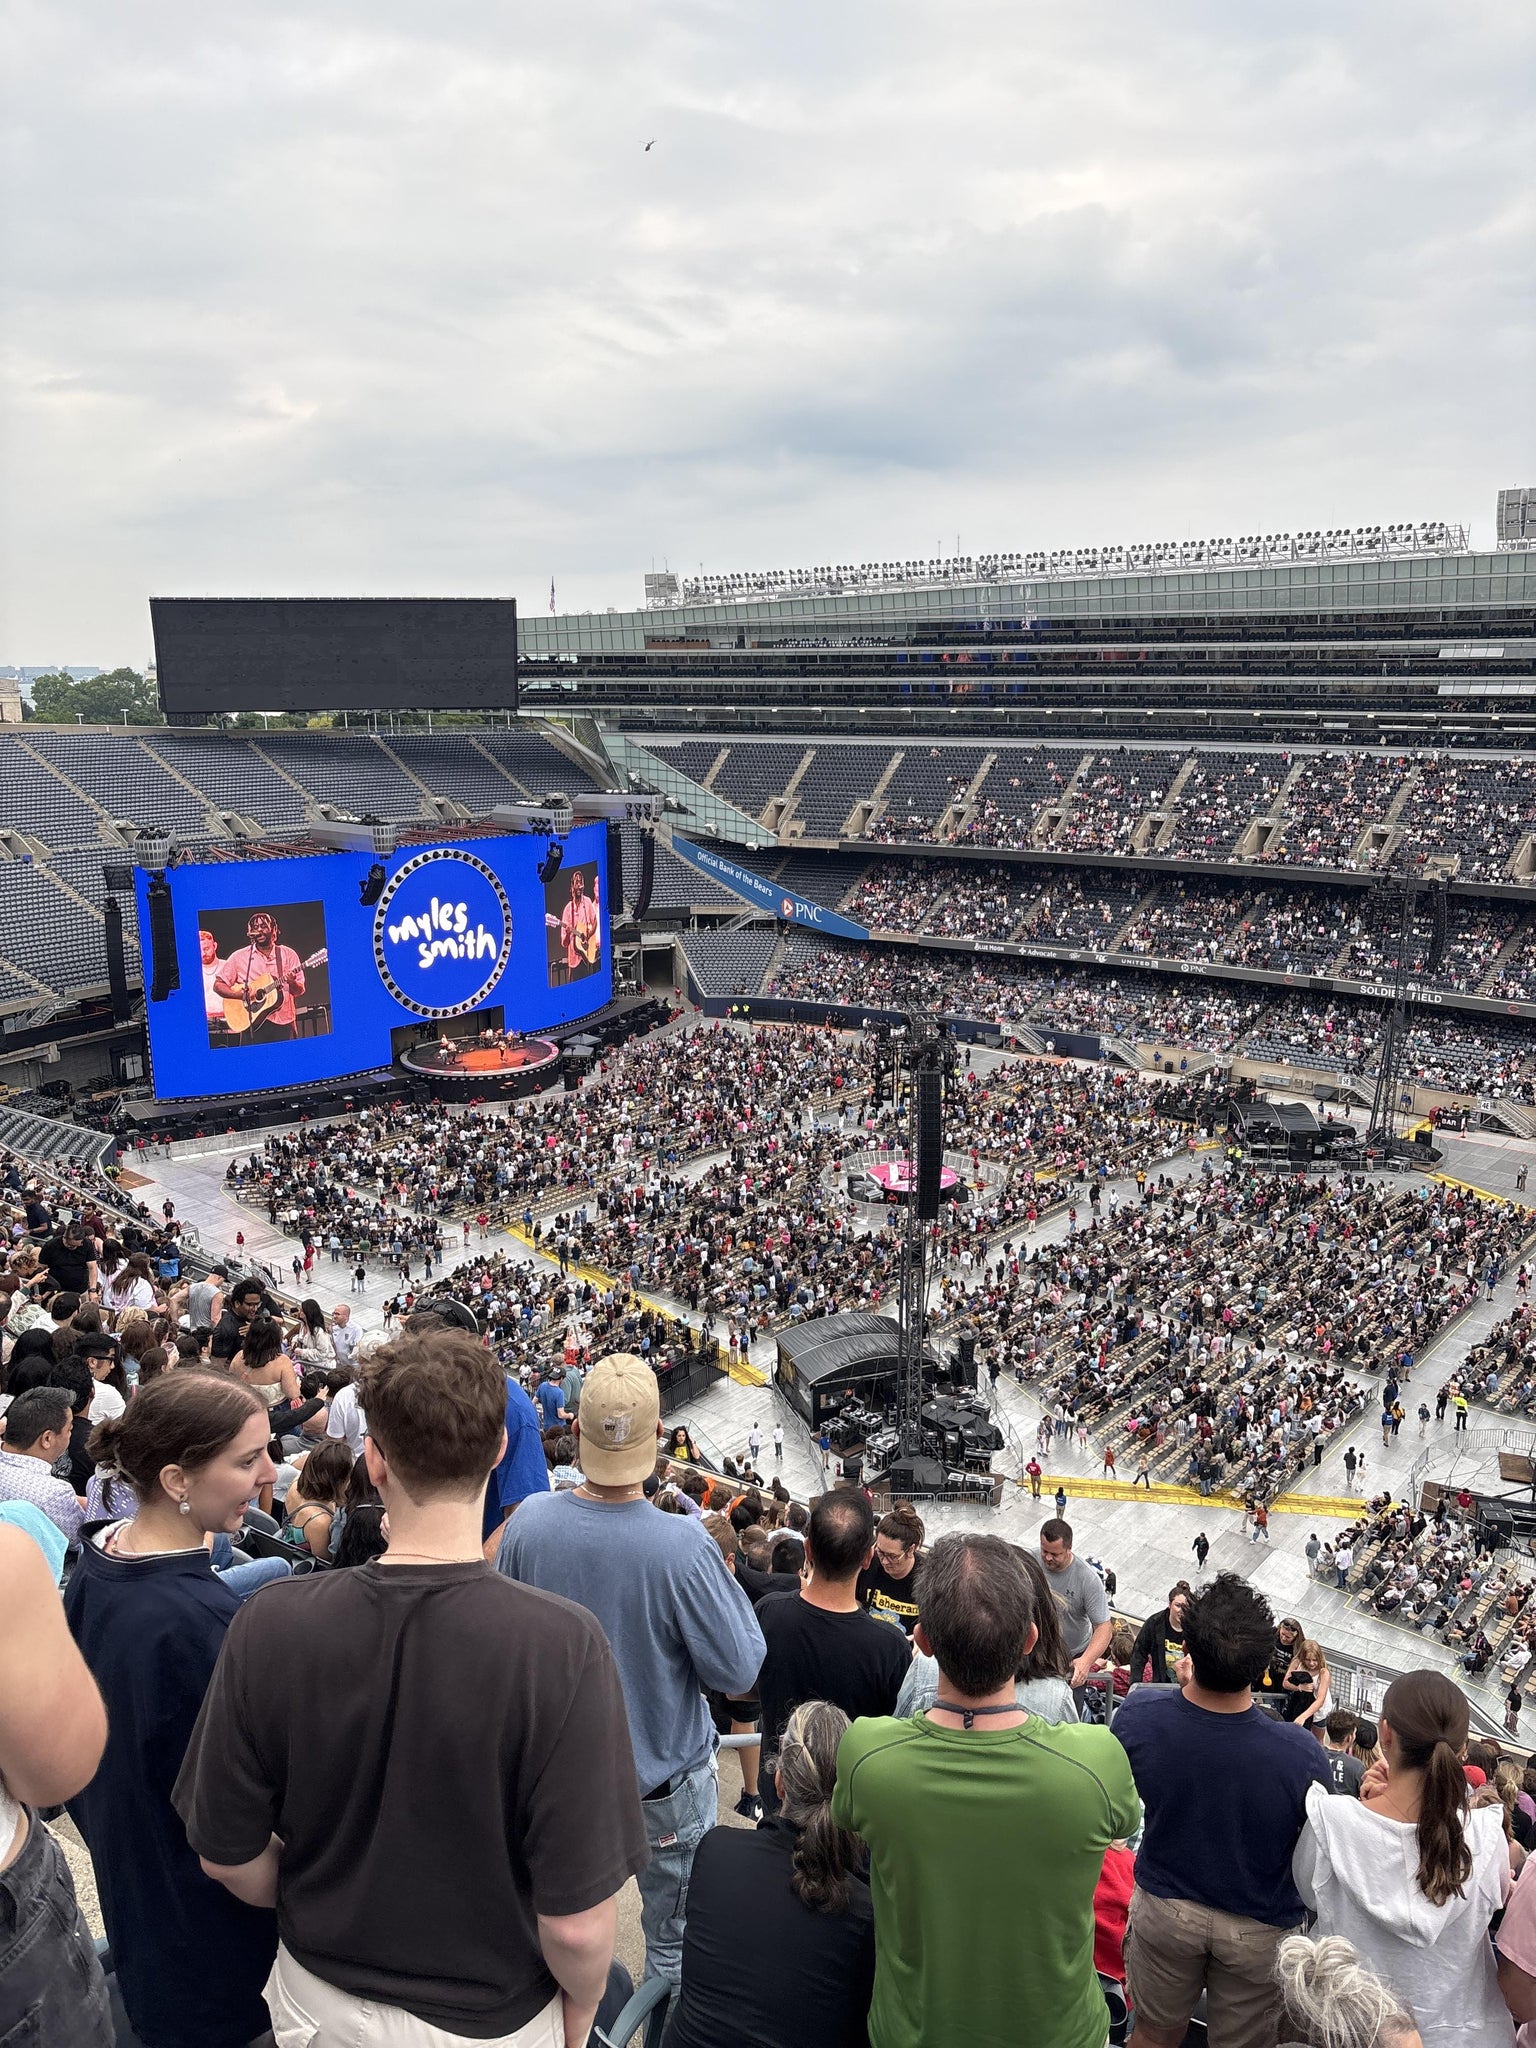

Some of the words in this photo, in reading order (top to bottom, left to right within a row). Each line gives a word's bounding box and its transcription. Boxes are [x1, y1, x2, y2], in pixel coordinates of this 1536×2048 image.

[697, 851, 718, 868] Official
[719, 862, 735, 877] Bank
[735, 871, 742, 880] of
[742, 875, 753, 886] the
[753, 879, 773, 897] Bears
[795, 902, 822, 922] PNC
[388, 897, 468, 944] myles
[418, 923, 497, 969] smith
[1027, 948, 1057, 959] Advocate
[1121, 958, 1150, 967] UNITED
[1189, 965, 1207, 974] PNC
[1411, 991, 1442, 1003] FIELD
[1441, 1118, 1457, 1127] BAR
[356, 1253, 362, 1261] E
[392, 1254, 398, 1262] E
[879, 1598, 919, 1614] sheeran
[1336, 1760, 1344, 1771] &
